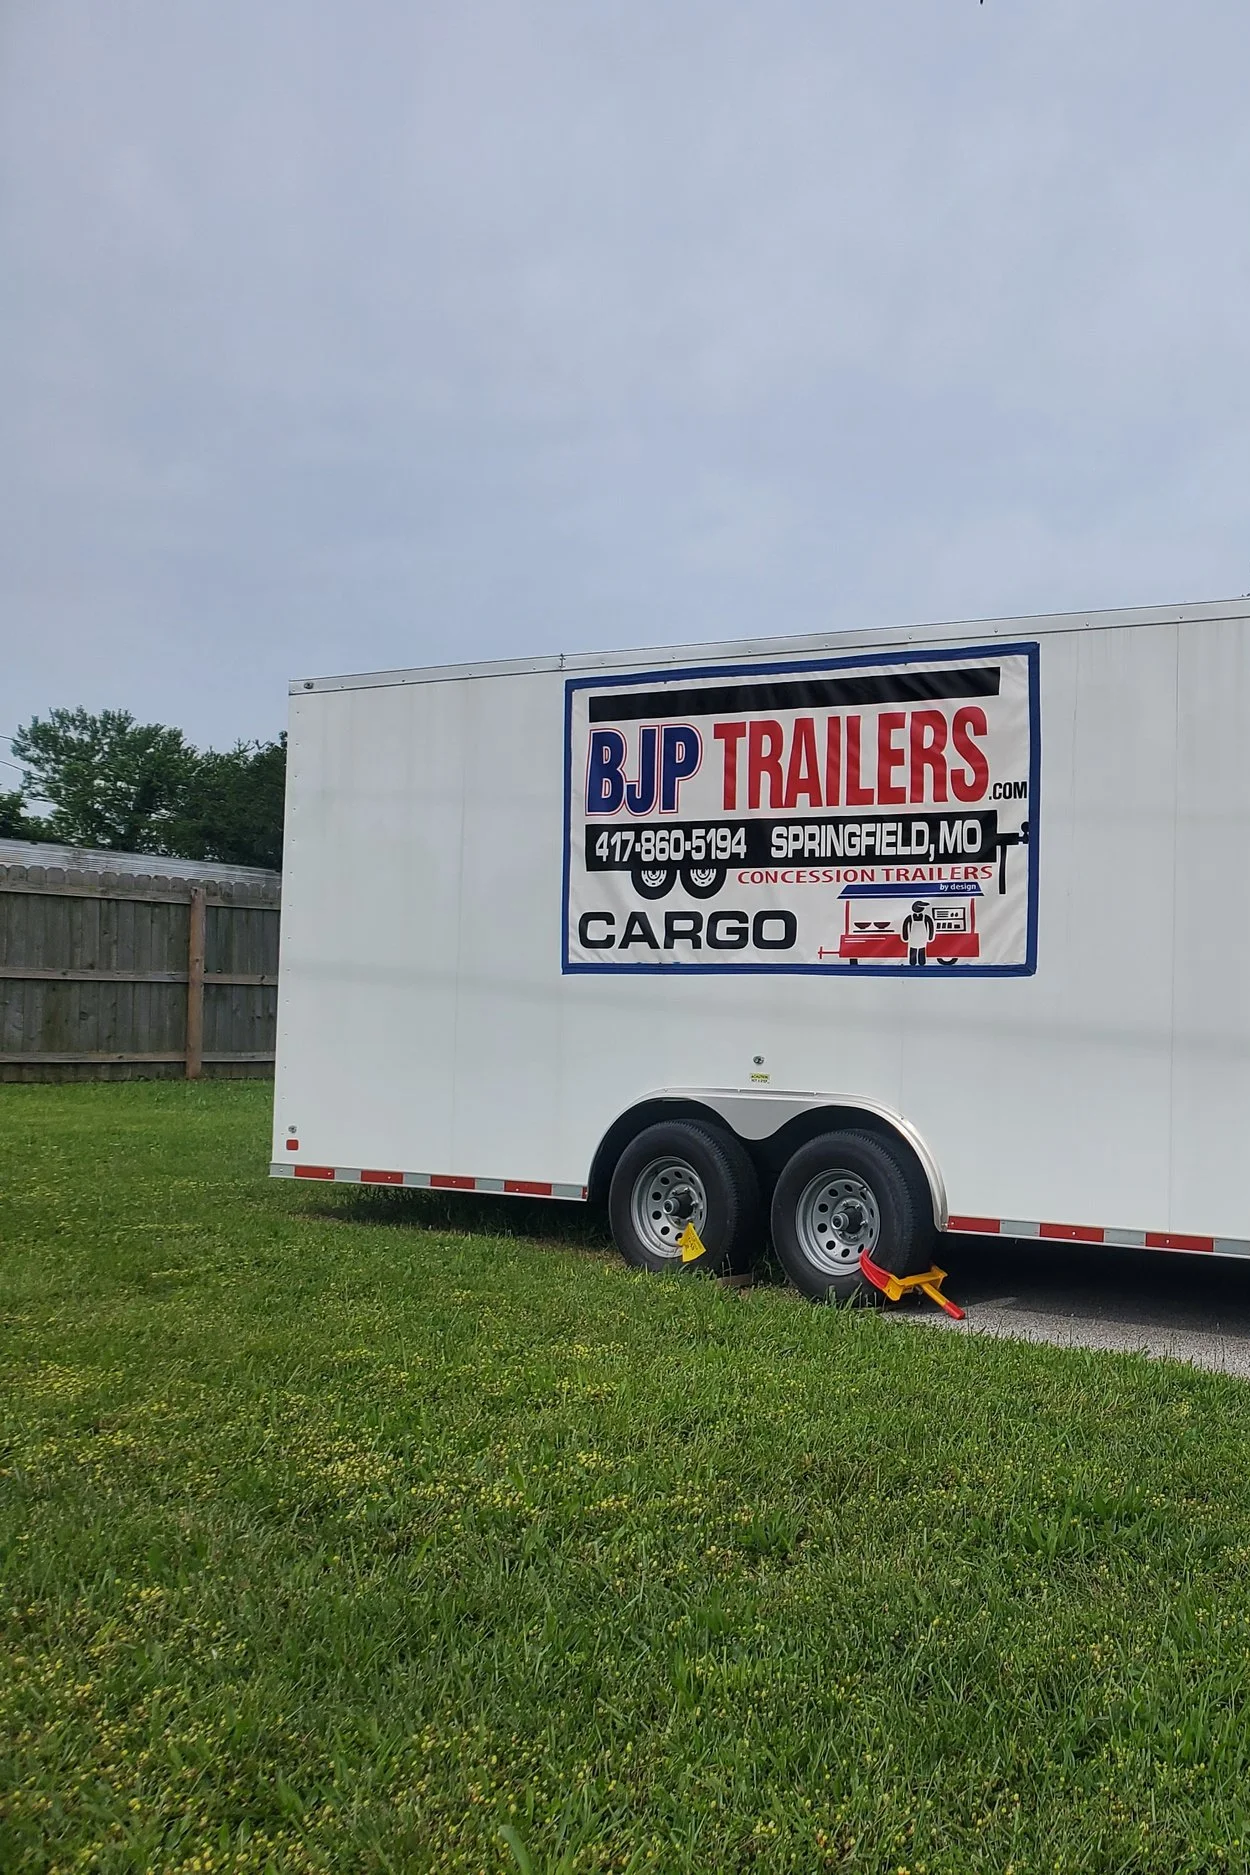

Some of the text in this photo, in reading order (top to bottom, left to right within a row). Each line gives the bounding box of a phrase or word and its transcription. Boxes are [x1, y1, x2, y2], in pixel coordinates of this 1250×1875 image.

[585, 706, 1028, 817] BJP TRAILERS .COM
[595, 827, 747, 862] 417-860-5194
[737, 866, 993, 885] CONCESSION TRAILERS
[939, 883, 977, 891] by design
[578, 910, 798, 950] CARGO
